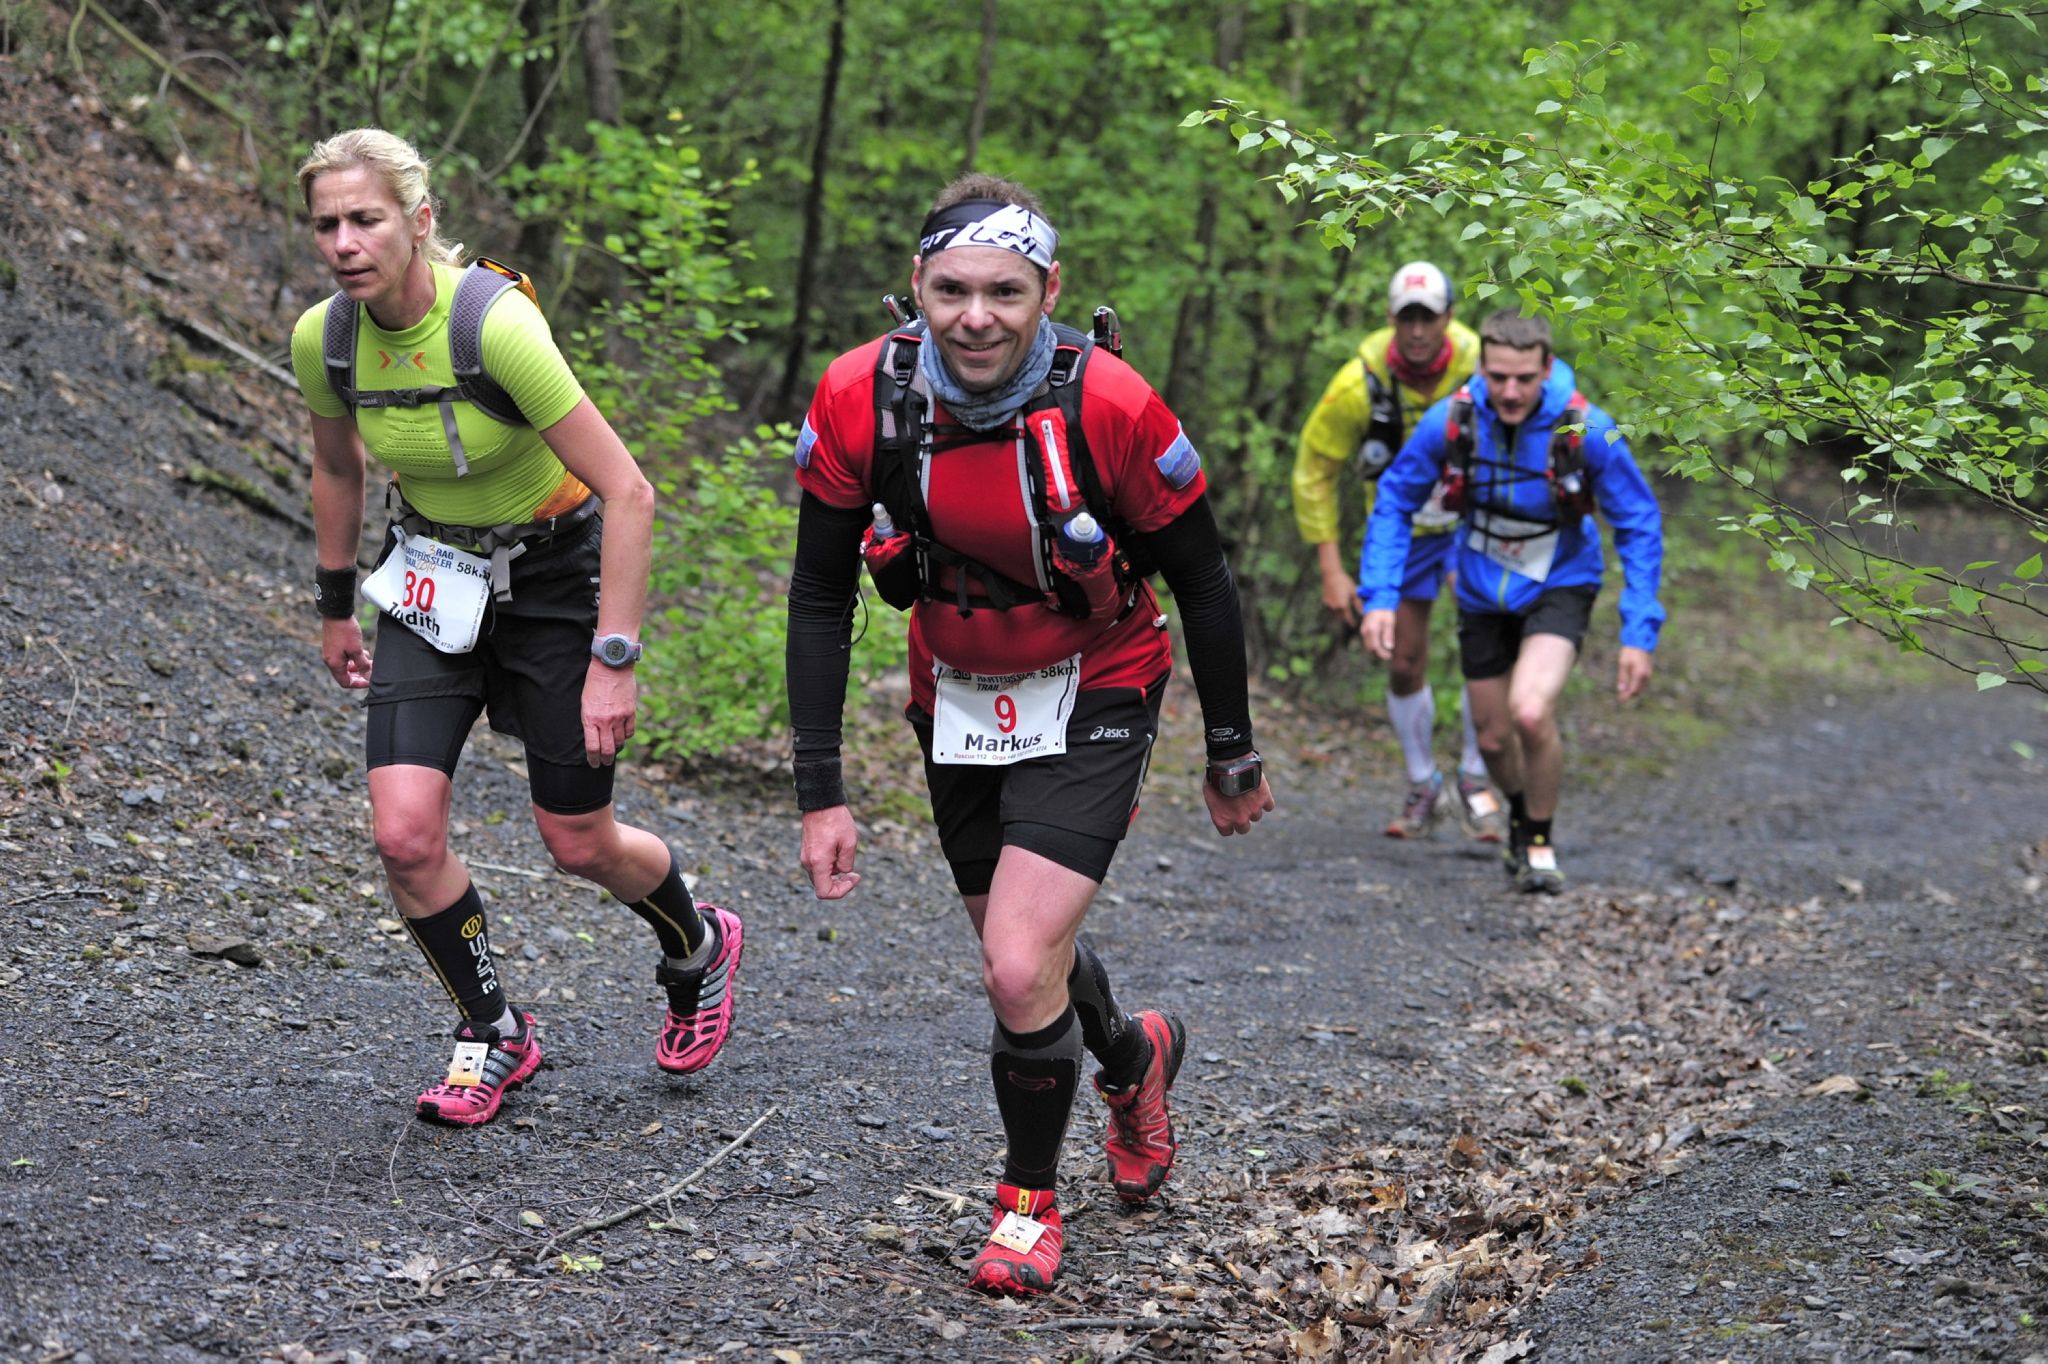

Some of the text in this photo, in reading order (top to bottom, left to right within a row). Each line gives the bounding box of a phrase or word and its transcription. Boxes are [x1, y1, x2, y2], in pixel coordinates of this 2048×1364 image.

[1041, 665, 1078, 679] 58km
[995, 694, 1017, 733] 9
[965, 733, 1043, 752] Markus
[977, 752, 987, 760] 112
